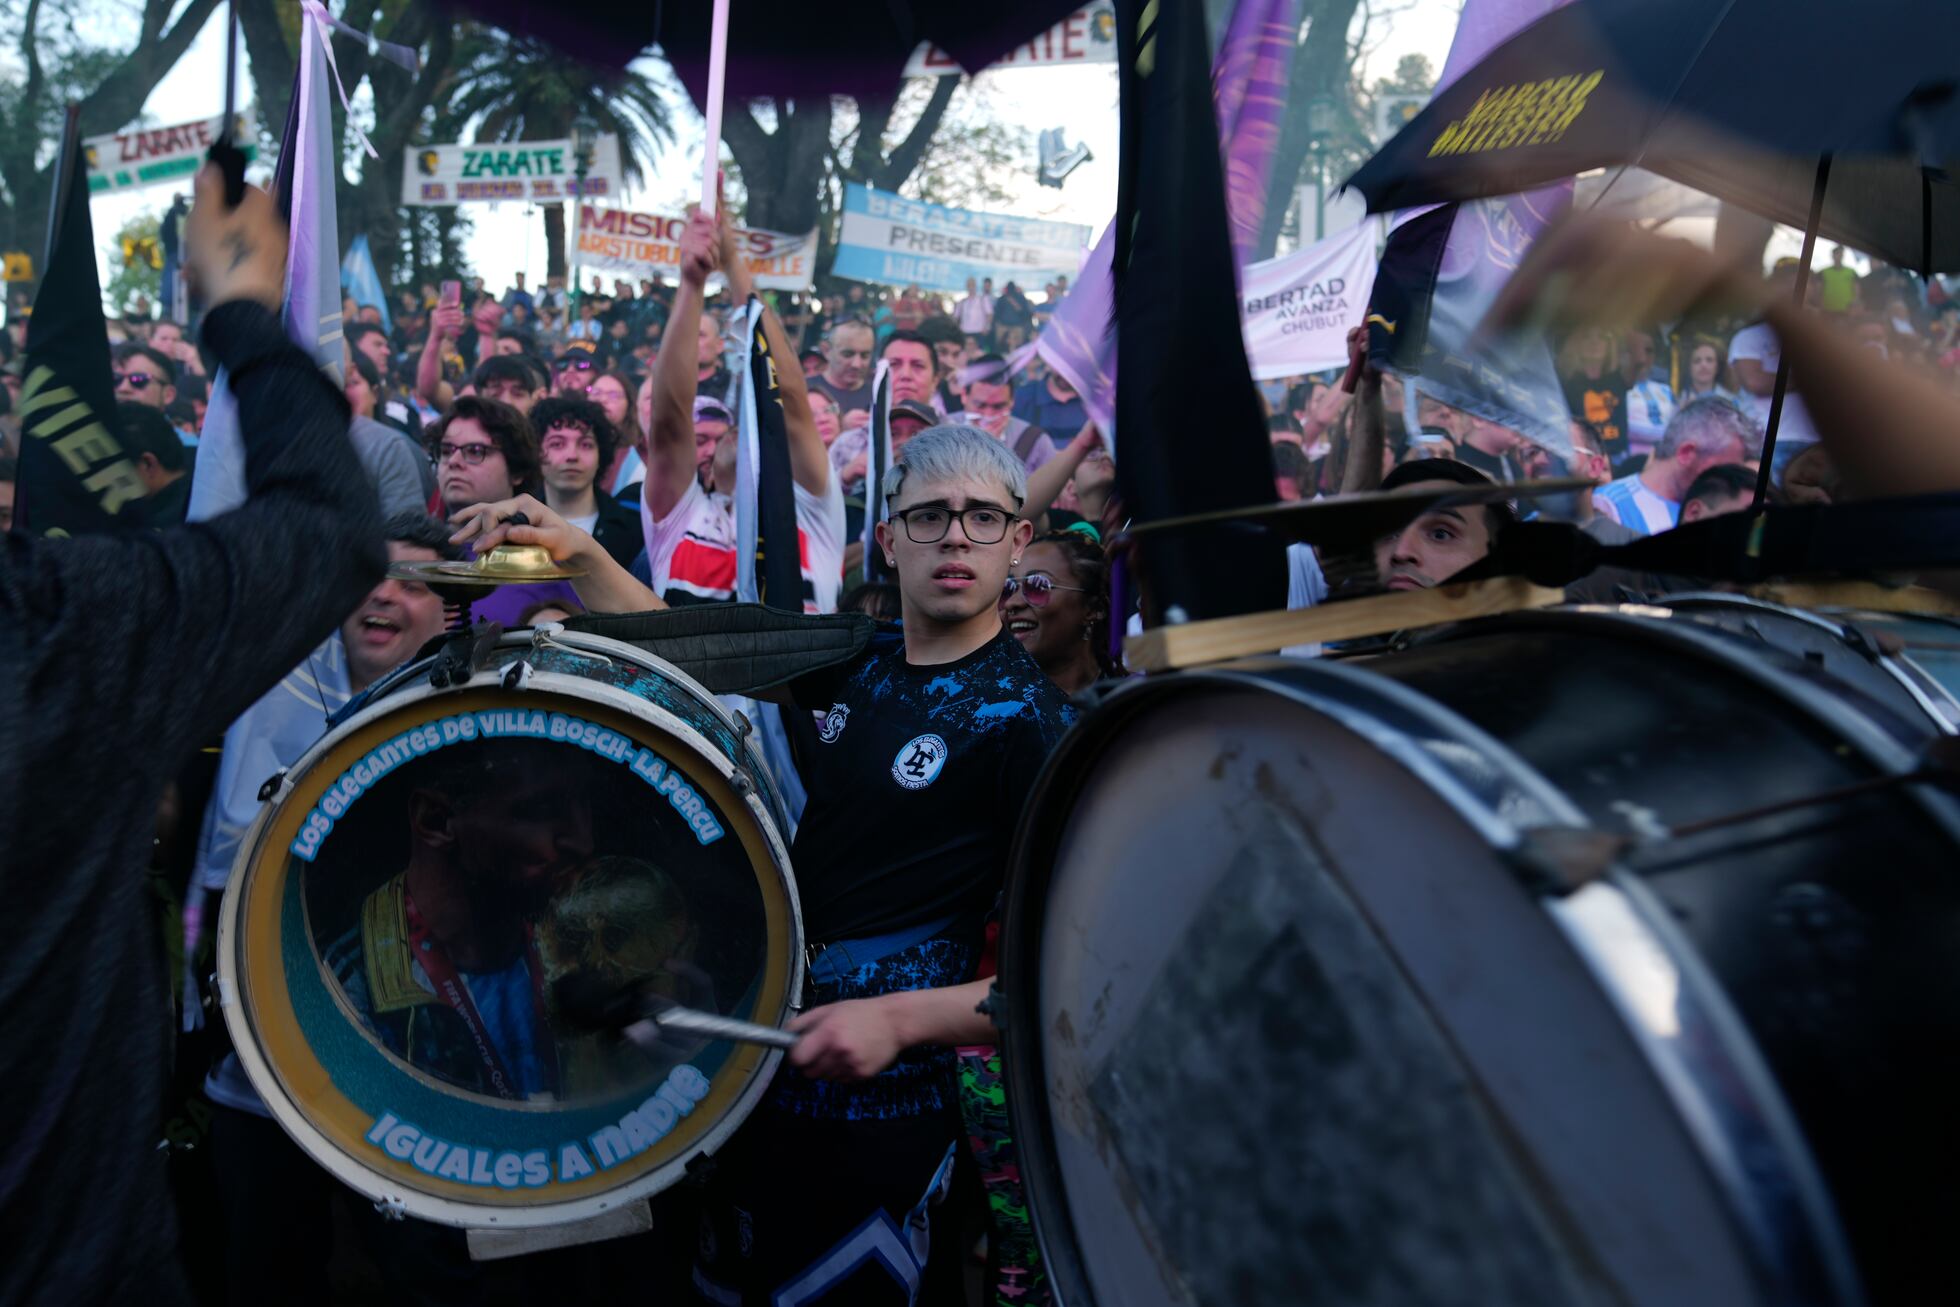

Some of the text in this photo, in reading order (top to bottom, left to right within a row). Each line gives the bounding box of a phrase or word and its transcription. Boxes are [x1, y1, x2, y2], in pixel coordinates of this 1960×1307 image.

[114, 120, 213, 163] ZARATE
[456, 149, 565, 177] ZARATE
[888, 225, 1042, 265] PRESENTE
[1276, 298, 1348, 321] AVANZA
[1280, 312, 1347, 336] CHUBUT
[293, 810, 332, 859] LOS
[478, 710, 546, 735] VILLA
[632, 750, 663, 783] LA
[559, 1142, 594, 1182] A
